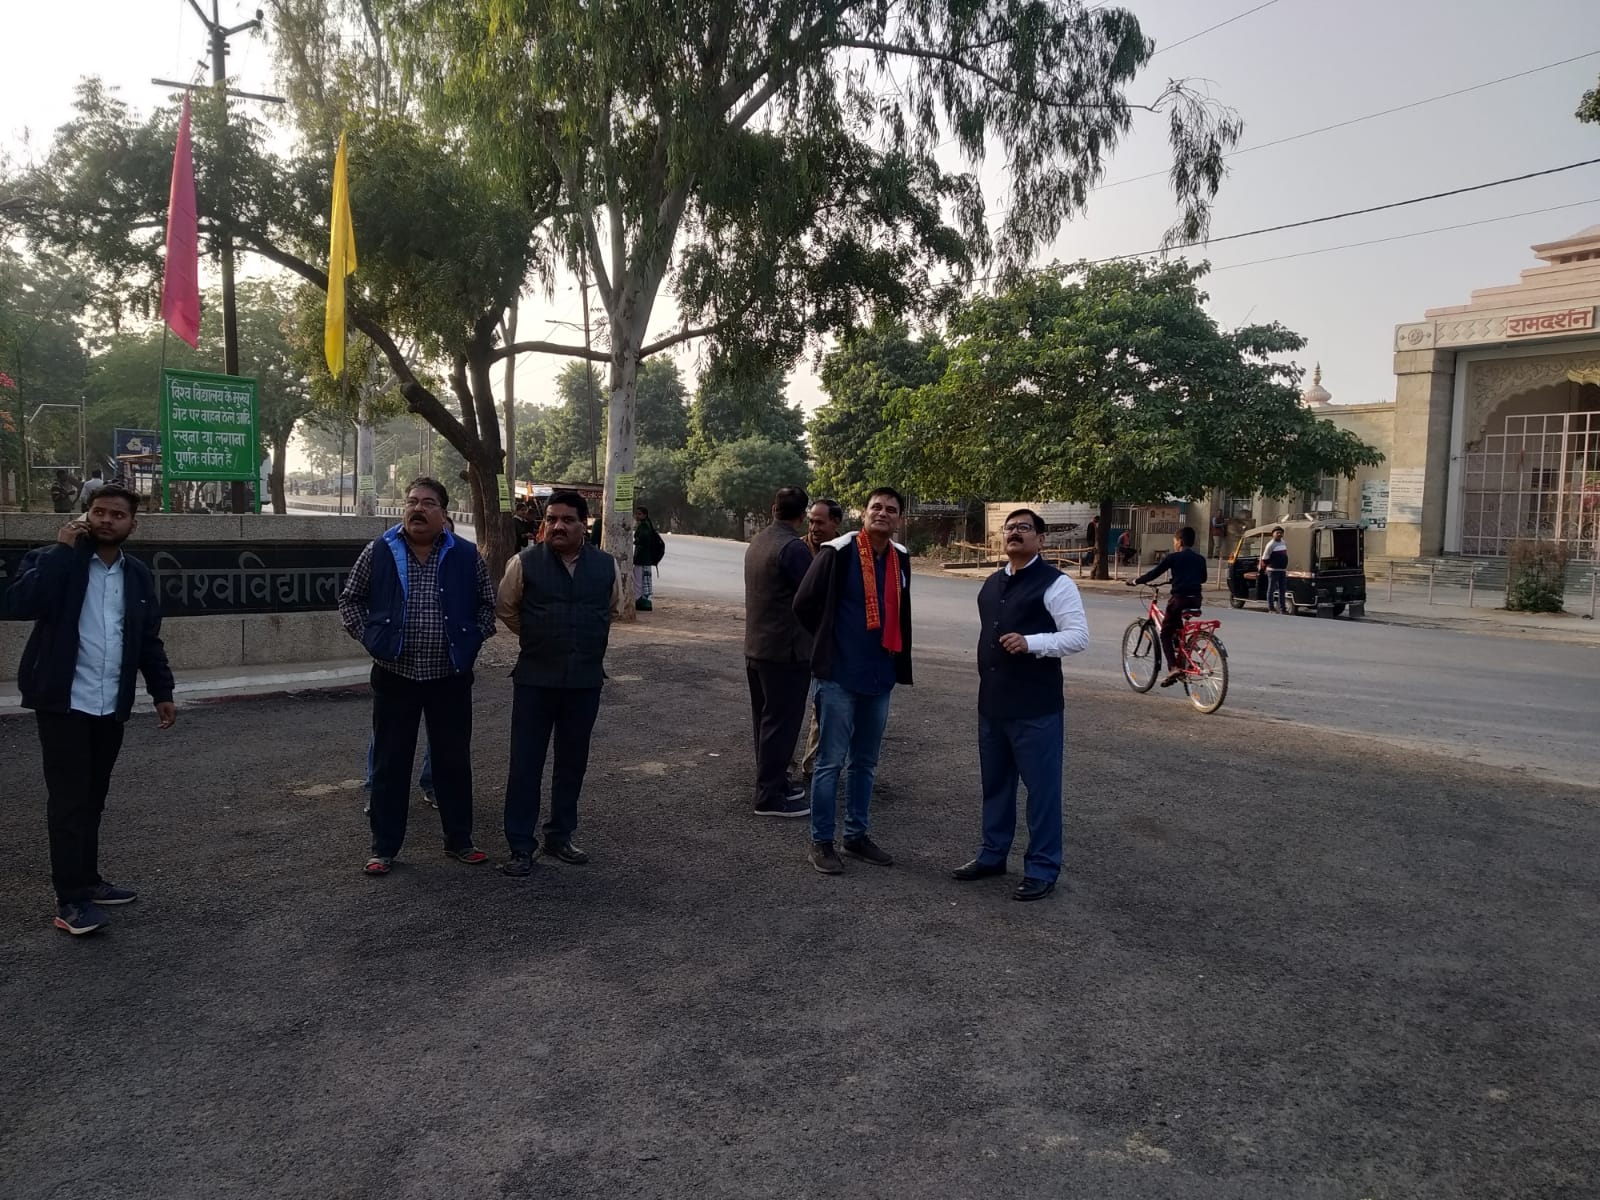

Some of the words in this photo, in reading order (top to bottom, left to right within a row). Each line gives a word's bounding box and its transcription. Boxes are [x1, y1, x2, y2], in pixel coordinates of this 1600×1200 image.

[1508, 309, 1591, 333] रामदर्शन
[192, 383, 224, 405] विद्यालय
[224, 386, 233, 404] के
[233, 391, 250, 409] मुख्य
[172, 402, 187, 422] गेट
[189, 408, 201, 425] पर
[201, 409, 221, 424] वाहन
[221, 406, 235, 426] ठेले
[172, 430, 199, 447] रखना
[201, 431, 213, 445] या
[215, 432, 247, 448] लगाना
[201, 446, 225, 468] वर्जित
[151, 551, 353, 607] विश्वविद्याल
